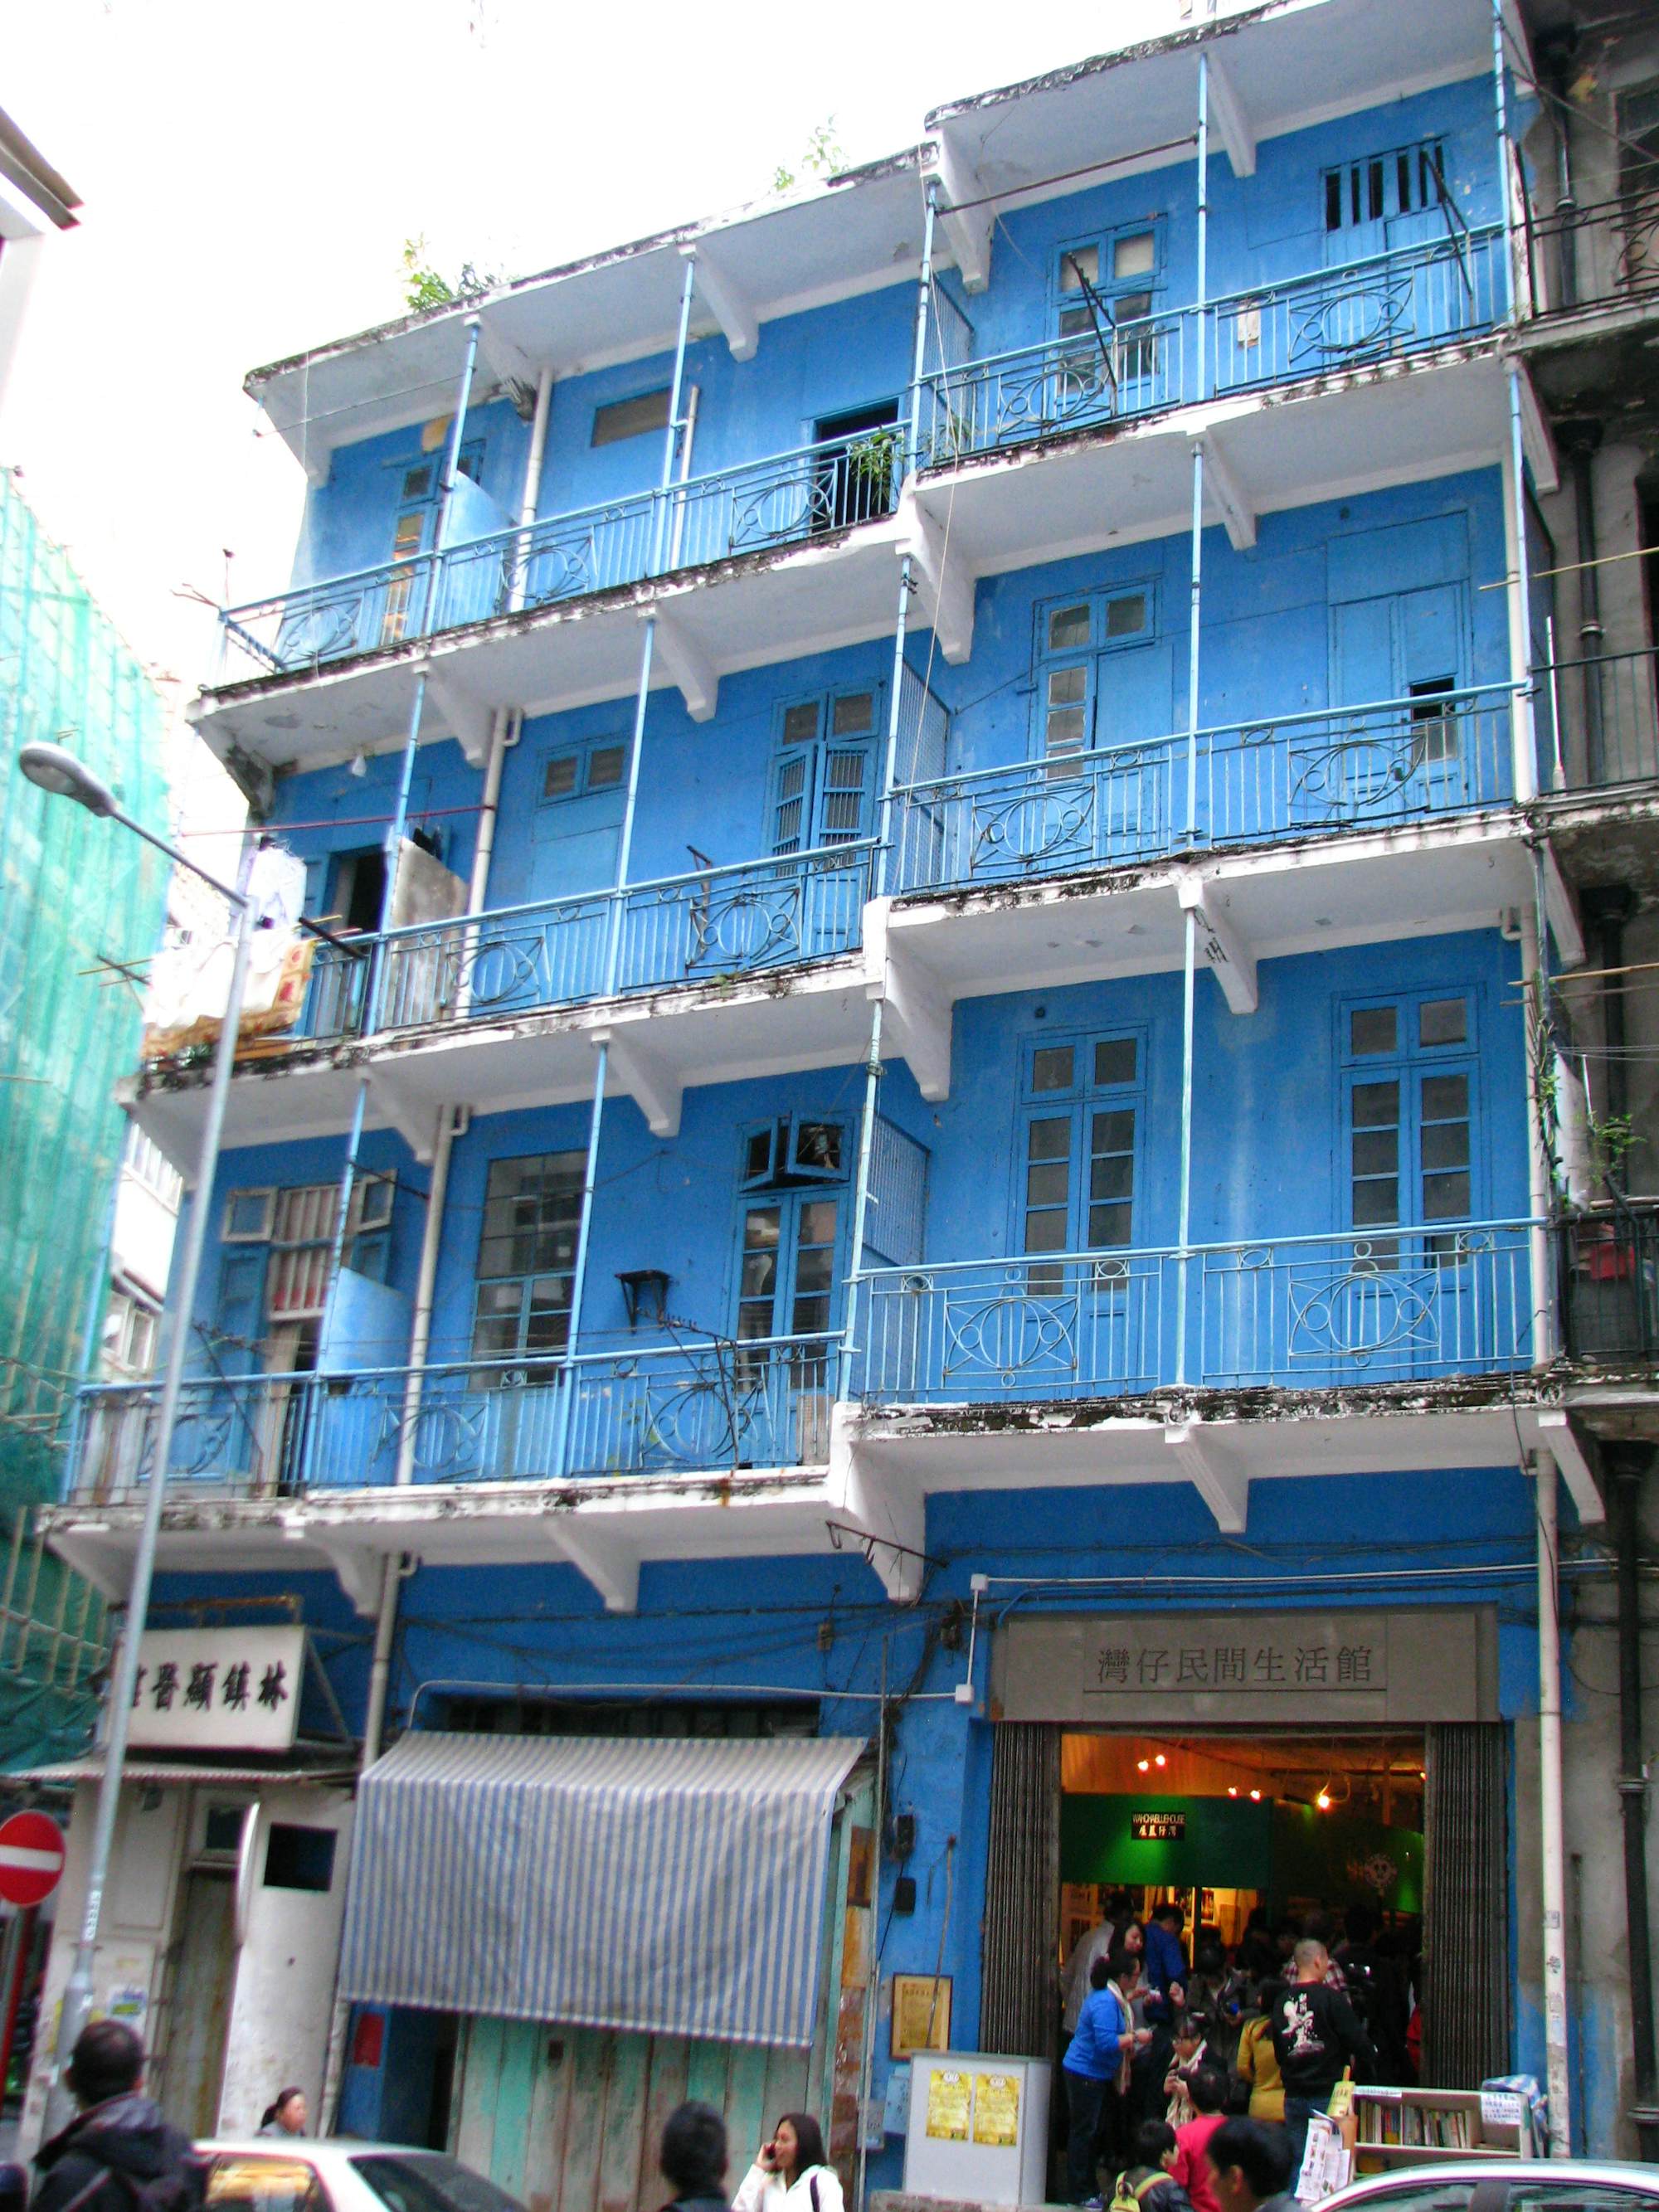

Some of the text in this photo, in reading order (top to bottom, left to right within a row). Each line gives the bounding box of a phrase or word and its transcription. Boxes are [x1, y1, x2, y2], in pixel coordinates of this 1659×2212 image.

[1097, 1645, 1372, 1684] 灣仔民間生活館
